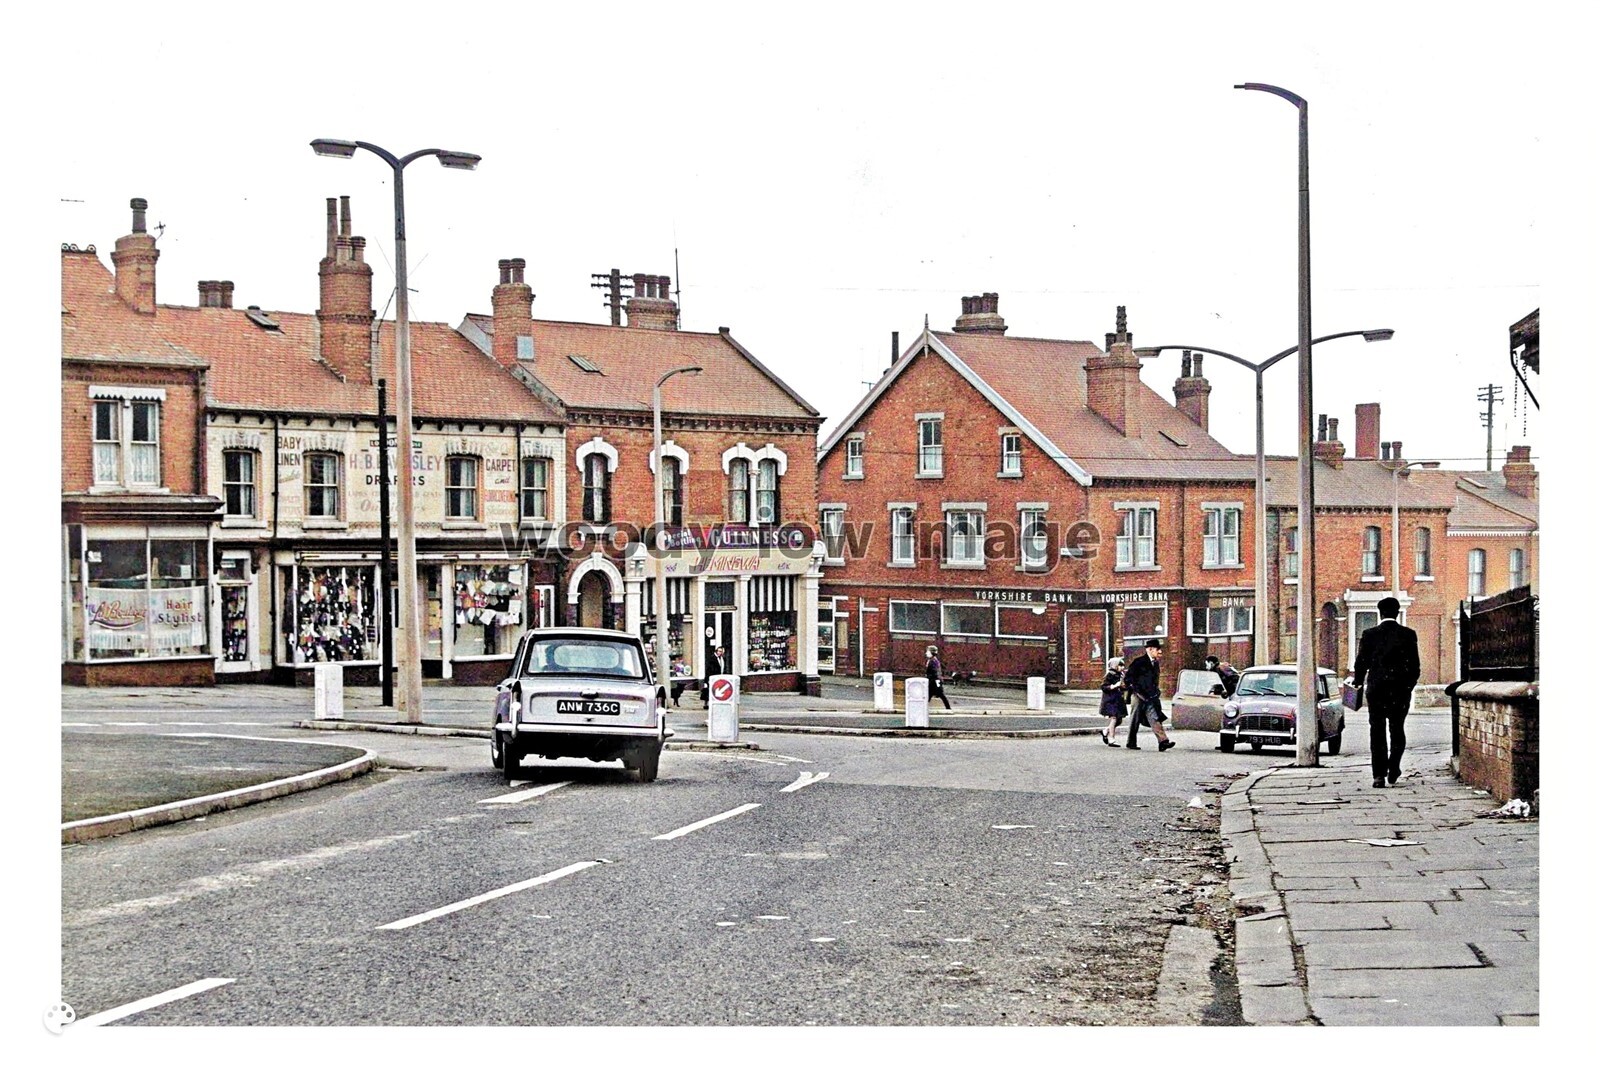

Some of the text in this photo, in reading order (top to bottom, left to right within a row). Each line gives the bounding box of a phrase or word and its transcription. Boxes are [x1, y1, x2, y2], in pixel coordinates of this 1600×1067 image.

[277, 436, 301, 449] BABY
[485, 458, 516, 472] CARPET
[710, 528, 789, 548] GUINNESS
[975, 591, 1073, 603] YORKSHIRE BANK
[1100, 592, 1168, 603] YORKSHIRE BANK
[1222, 597, 1245, 607] BANK
[165, 598, 193, 611] Hair
[157, 611, 203, 628] Stylist
[558, 701, 583, 712] ANW
[586, 702, 619, 713] 736C
